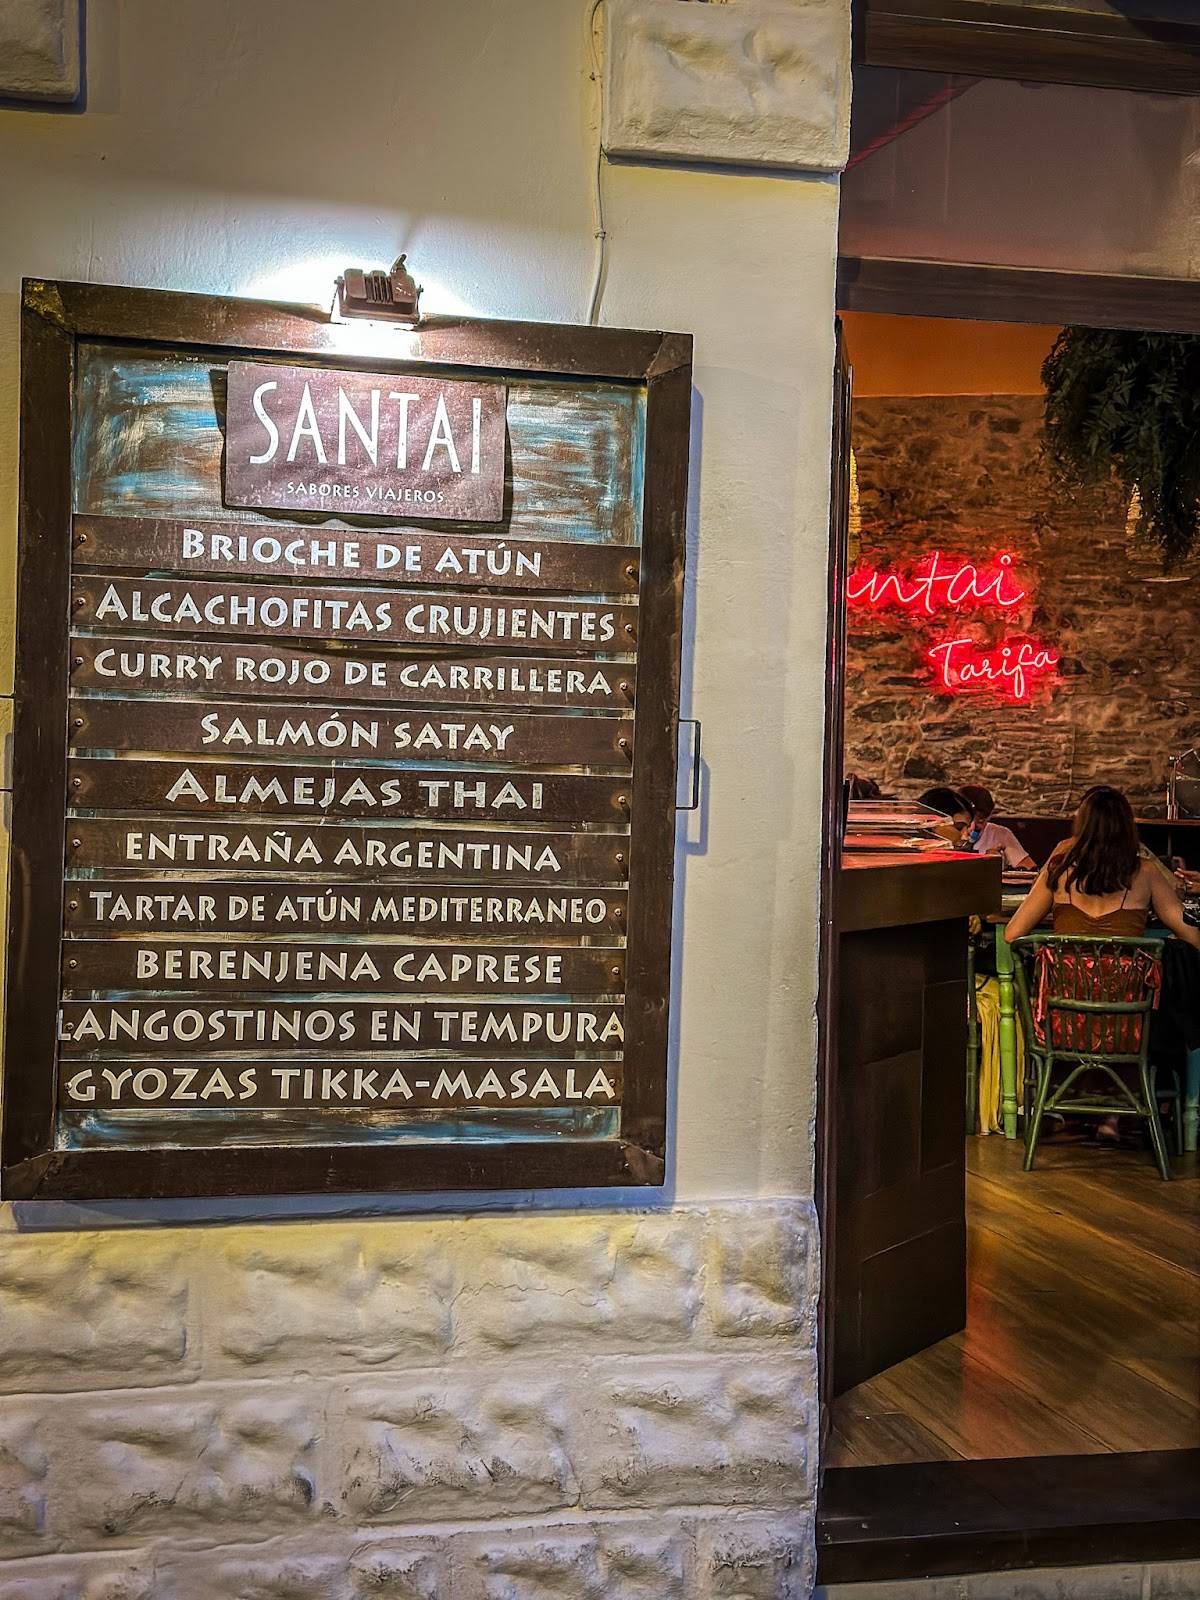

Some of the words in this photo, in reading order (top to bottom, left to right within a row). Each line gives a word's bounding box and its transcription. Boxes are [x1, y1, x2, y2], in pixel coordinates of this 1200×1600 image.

[249, 380, 482, 474] SANTAI
[287, 481, 362, 499] SABORES
[366, 486, 445, 503] VIAJEROS
[182, 528, 359, 568] BRIOCHE
[376, 543, 422, 571] DE
[435, 542, 541, 577] ATÚN
[95, 584, 393, 631] ALCACHOFITAS
[405, 603, 615, 642] CRUJIENTES
[94, 648, 224, 679] CURRY
[235, 657, 332, 684] ROJO
[344, 661, 386, 686] DE
[400, 664, 612, 696] CARRILLERA
[929, 639, 1059, 698] Tarifa
[201, 712, 378, 748] SALMÓN
[394, 721, 514, 751] SATAY
[166, 768, 402, 808] ALMEJAS
[418, 780, 542, 810] THAI
[125, 831, 322, 865] ENTRAÑA
[333, 837, 561, 872] ARGENTINA
[89, 891, 216, 921] TARTAR
[228, 896, 265, 921] DE
[276, 890, 361, 923] ATÚN
[371, 897, 607, 925] MEDITERRANEO
[136, 949, 381, 982] BERENJENA
[393, 952, 562, 984] CAPRESE
[59, 1009, 356, 1042] LANGOSTINOS
[371, 1010, 422, 1042] EN
[434, 1011, 624, 1043] TEMPURA
[68, 1067, 257, 1101] GYOZAS
[272, 1068, 615, 1100] TIKKA-MASALA
